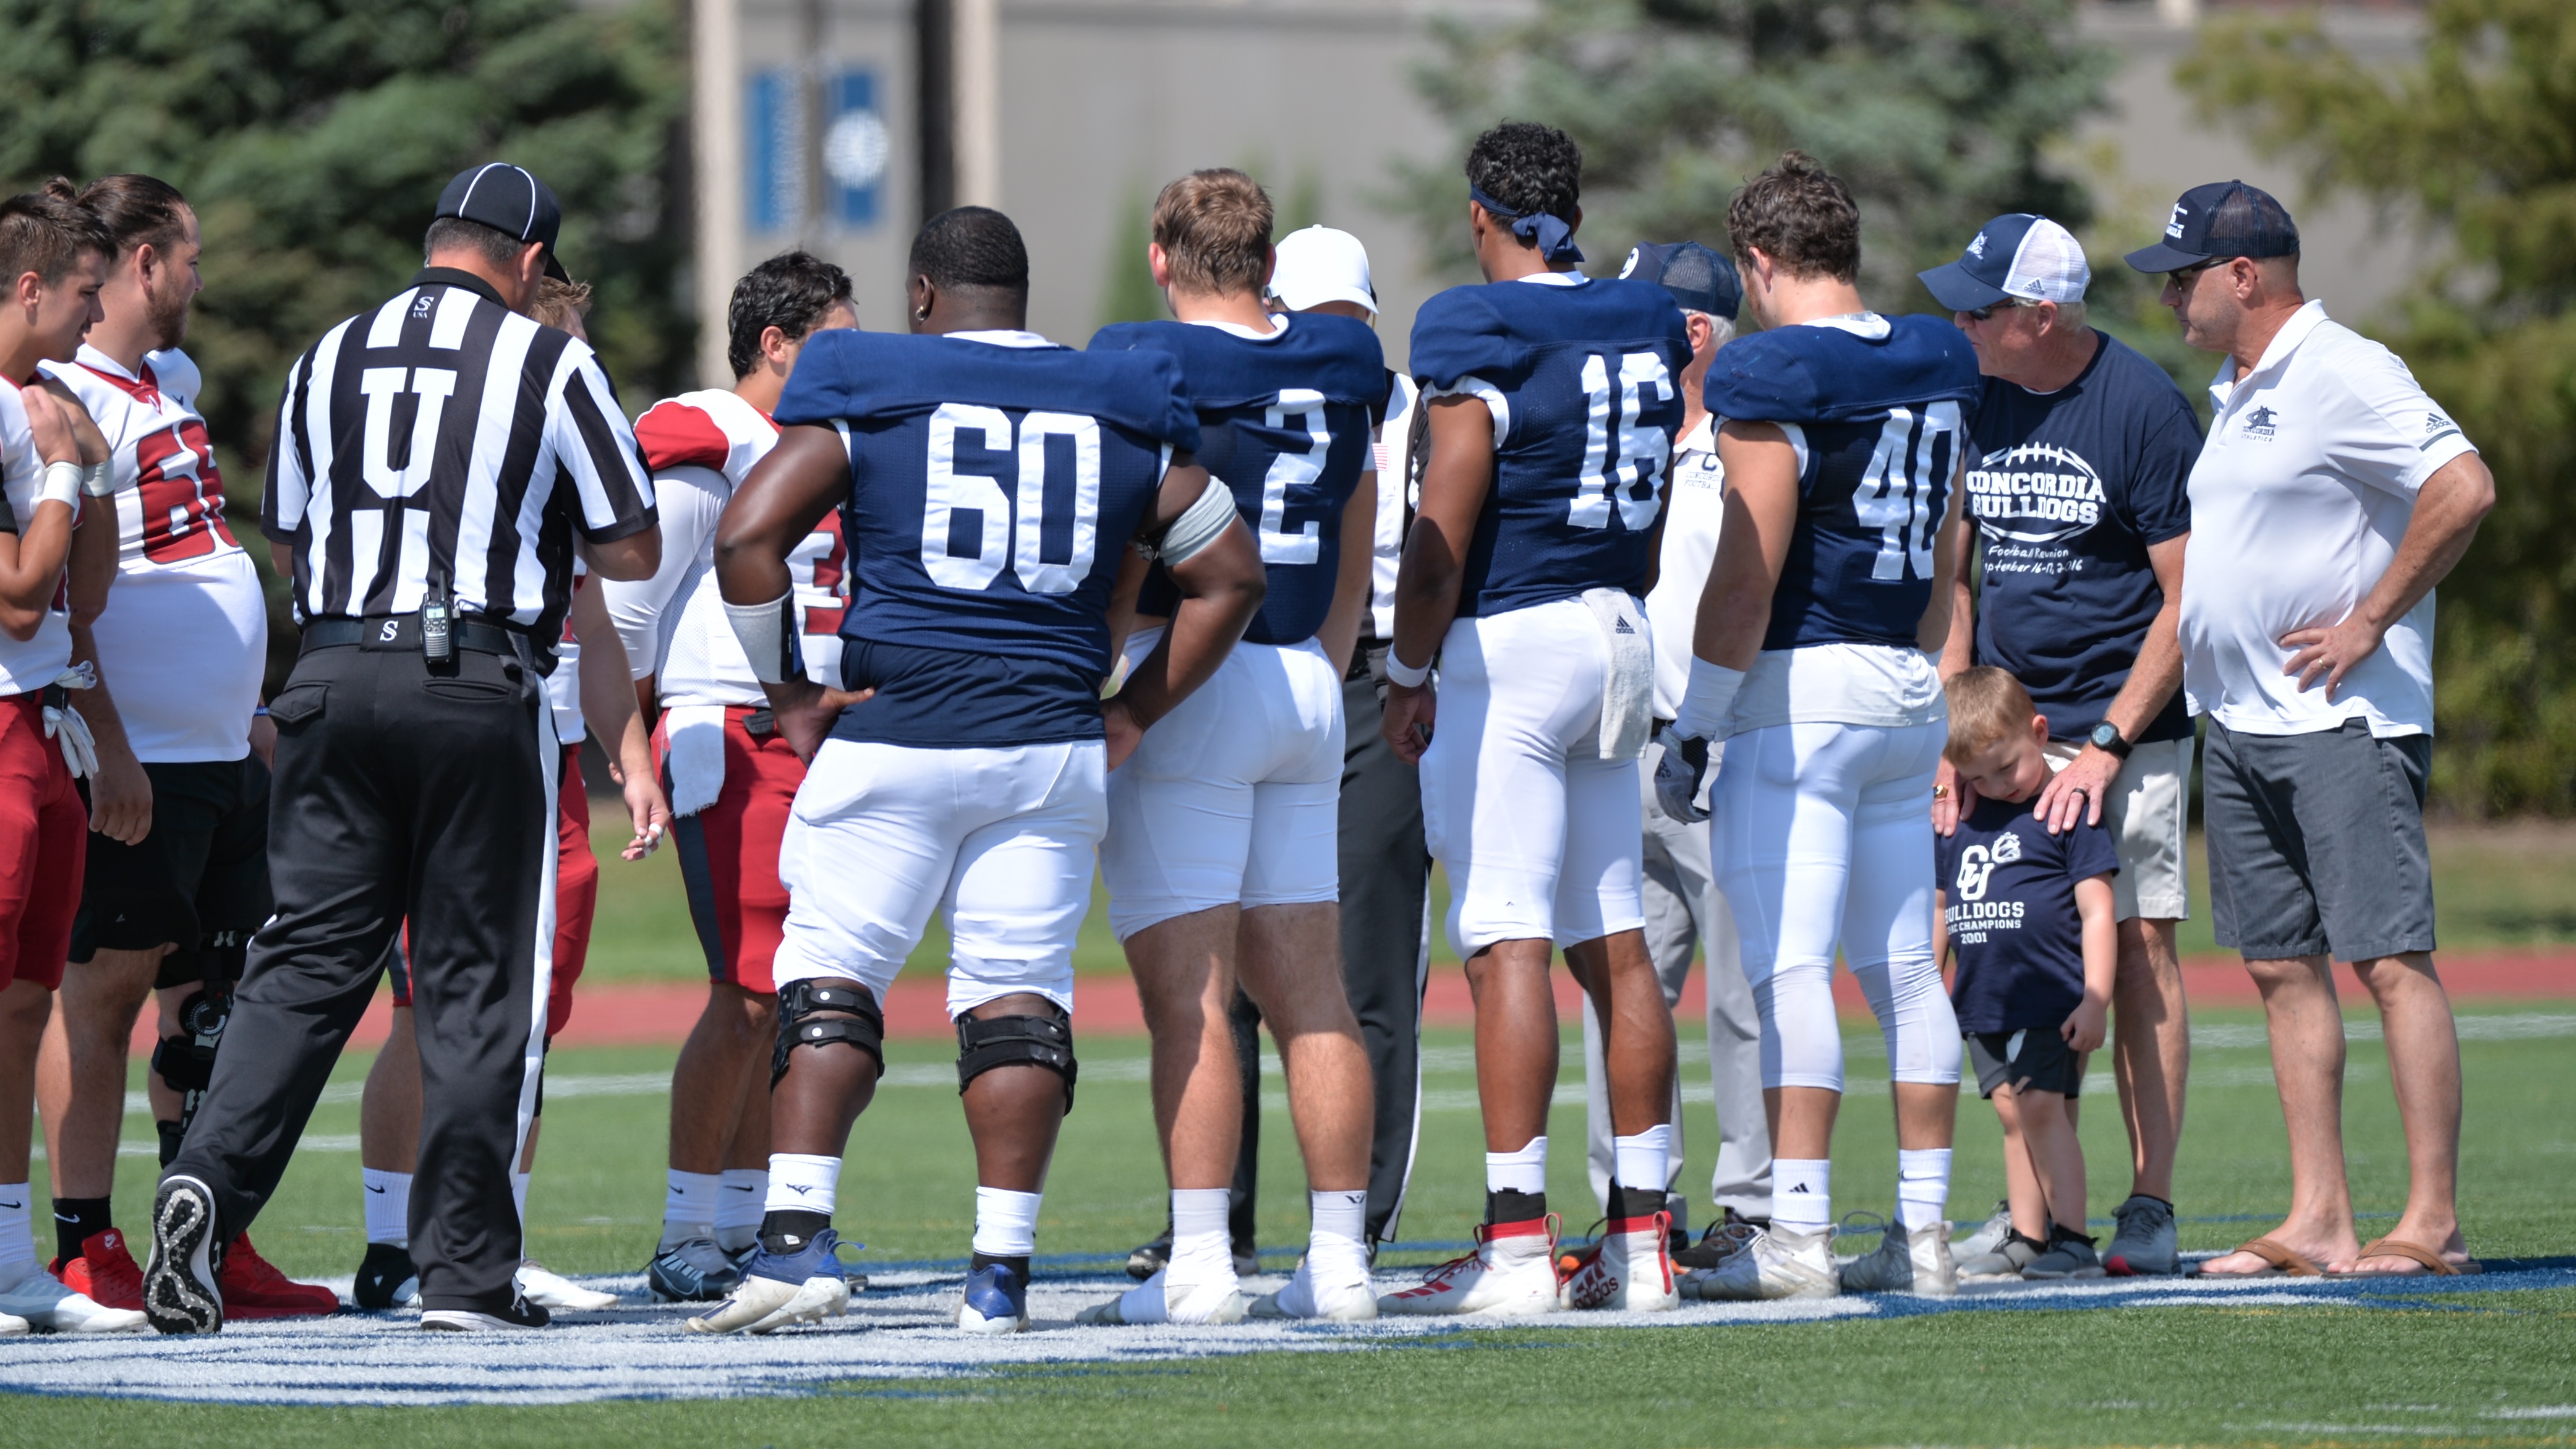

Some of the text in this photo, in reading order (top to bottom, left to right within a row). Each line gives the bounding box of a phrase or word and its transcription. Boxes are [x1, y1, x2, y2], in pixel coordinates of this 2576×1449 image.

[361, 367, 457, 499] U
[1567, 351, 1674, 531] 16
[1260, 388, 1331, 565] 2
[1852, 400, 1961, 580] 40
[1966, 471, 2107, 503] CONCORDIA
[921, 402, 1101, 594] 60
[1973, 494, 2099, 524] BULLDOGS
[1988, 544, 2069, 558] Football Reunion
[1958, 918, 2021, 931] CHAMPIONS
[1960, 931, 1987, 944] 2001
[1574, 1276, 1619, 1310] adidas
